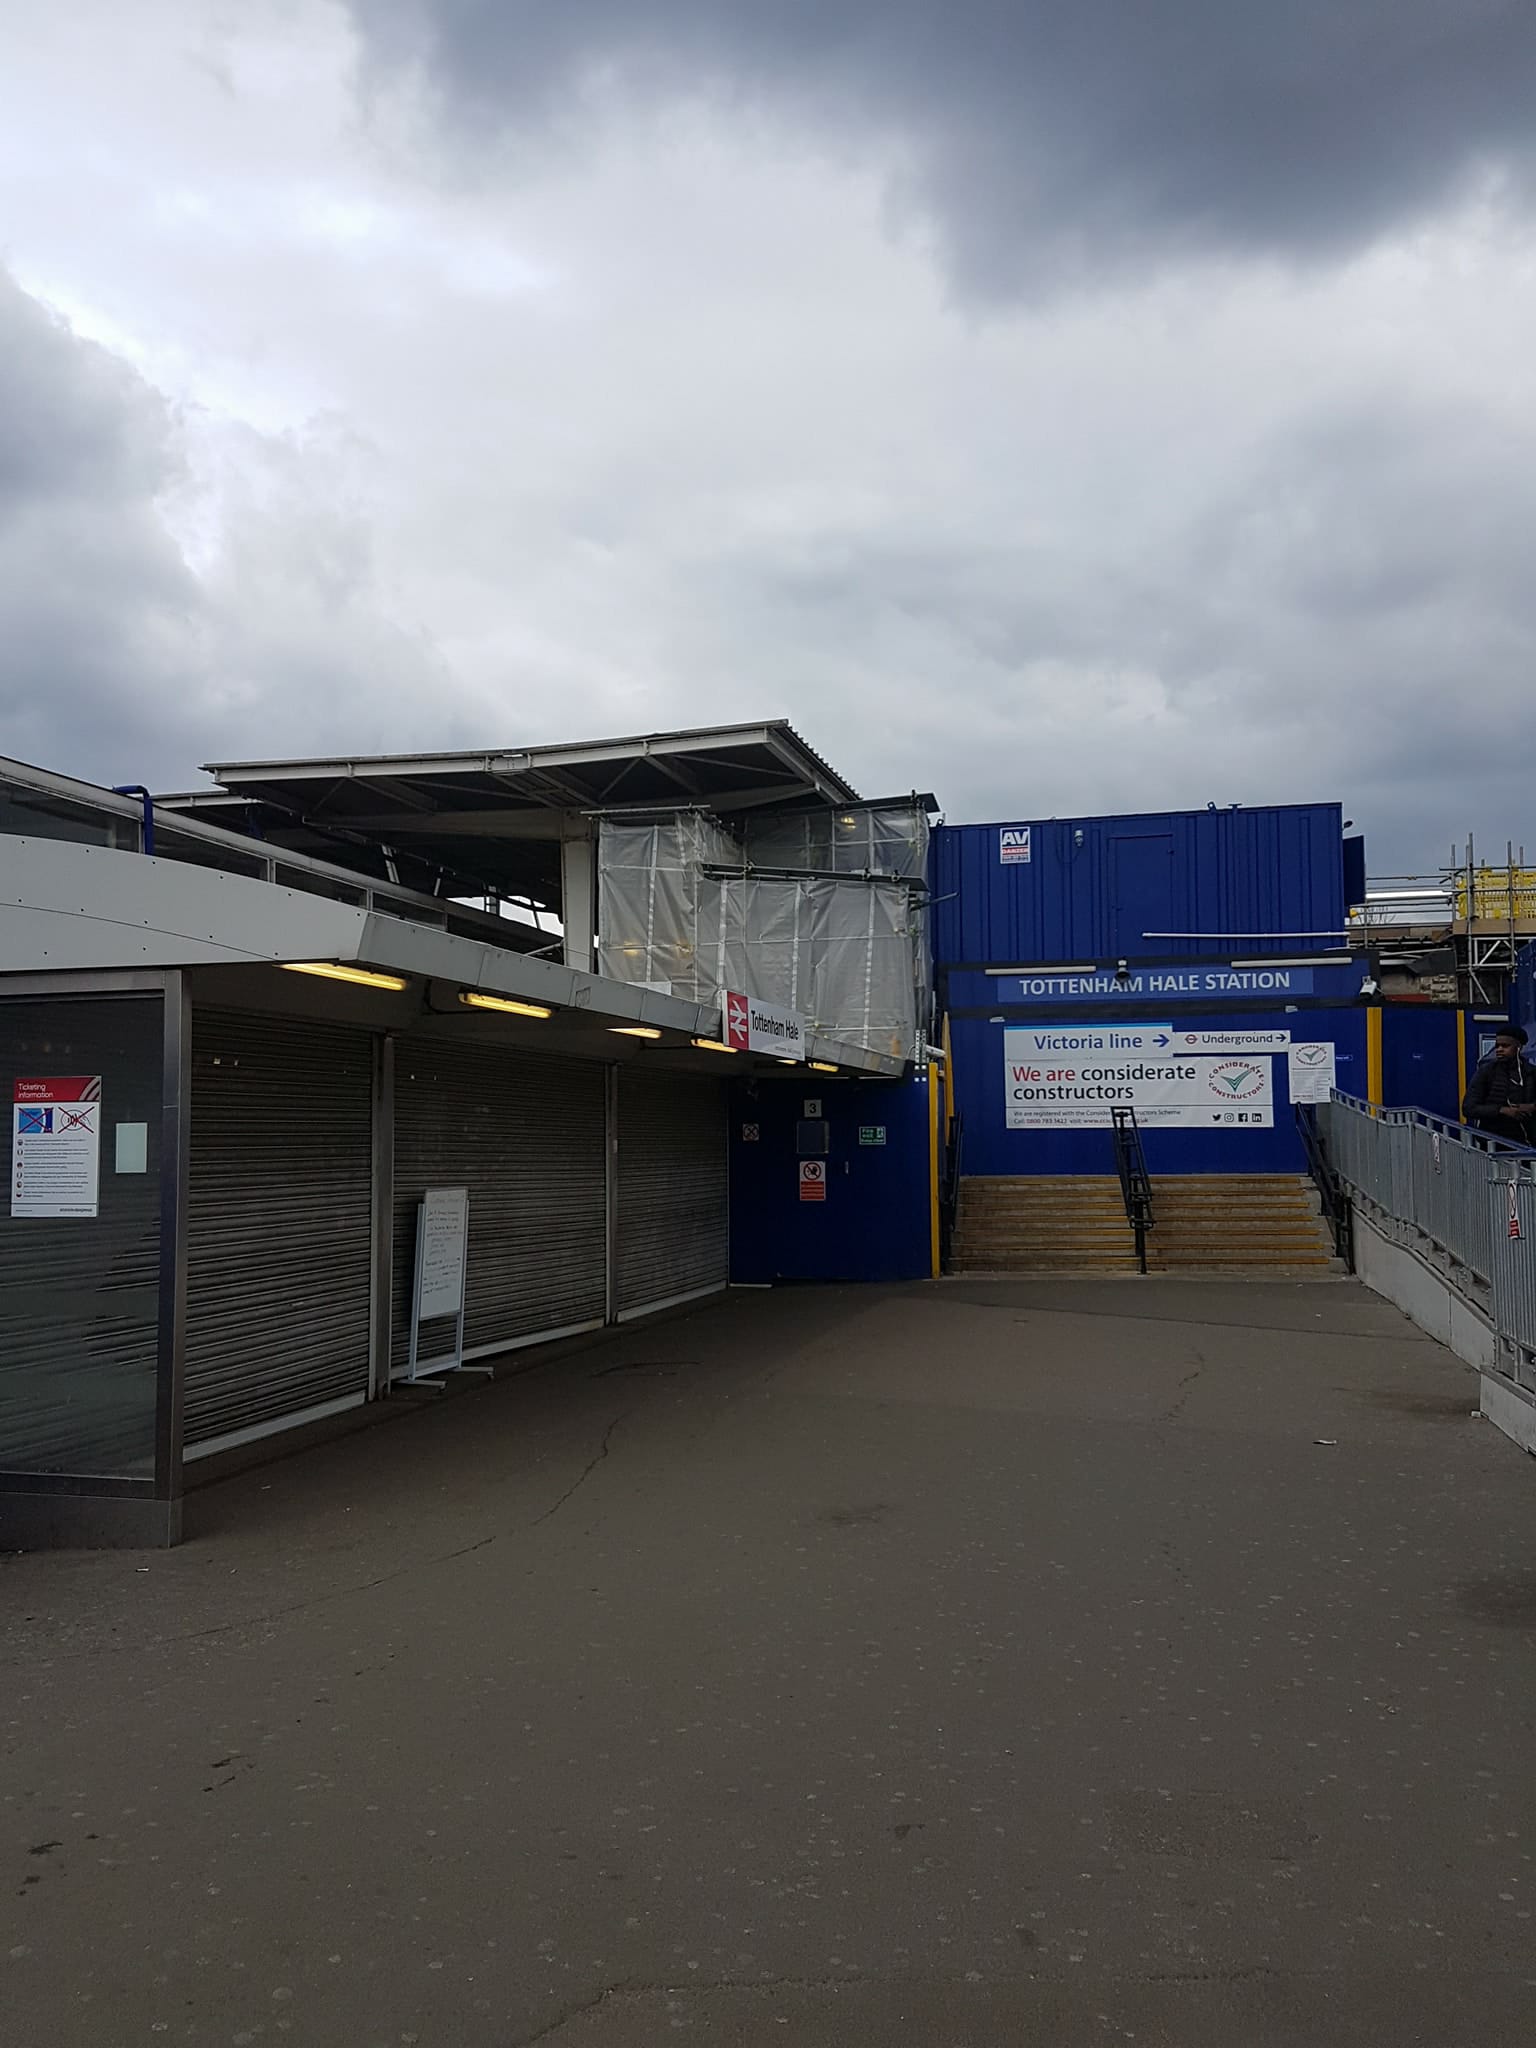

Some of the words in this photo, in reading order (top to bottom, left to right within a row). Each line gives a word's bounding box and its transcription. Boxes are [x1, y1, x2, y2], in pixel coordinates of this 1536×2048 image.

[1002, 831, 1028, 845] AV
[1019, 977, 1142, 995] TOTTENHAM
[1149, 974, 1199, 992] HALE
[1205, 972, 1290, 990] STATION
[751, 1010, 785, 1037] Tottenham
[786, 1019, 799, 1041] Hale
[1034, 1035, 1103, 1050] Victoria
[1109, 1033, 1143, 1048] line
[1202, 1034, 1273, 1045] Underground
[1012, 1066, 1041, 1082] We
[1046, 1068, 1075, 1081] are
[1081, 1064, 1196, 1081] considerate
[1013, 1085, 1134, 1100] constructors
[809, 1103, 817, 1114] 3
